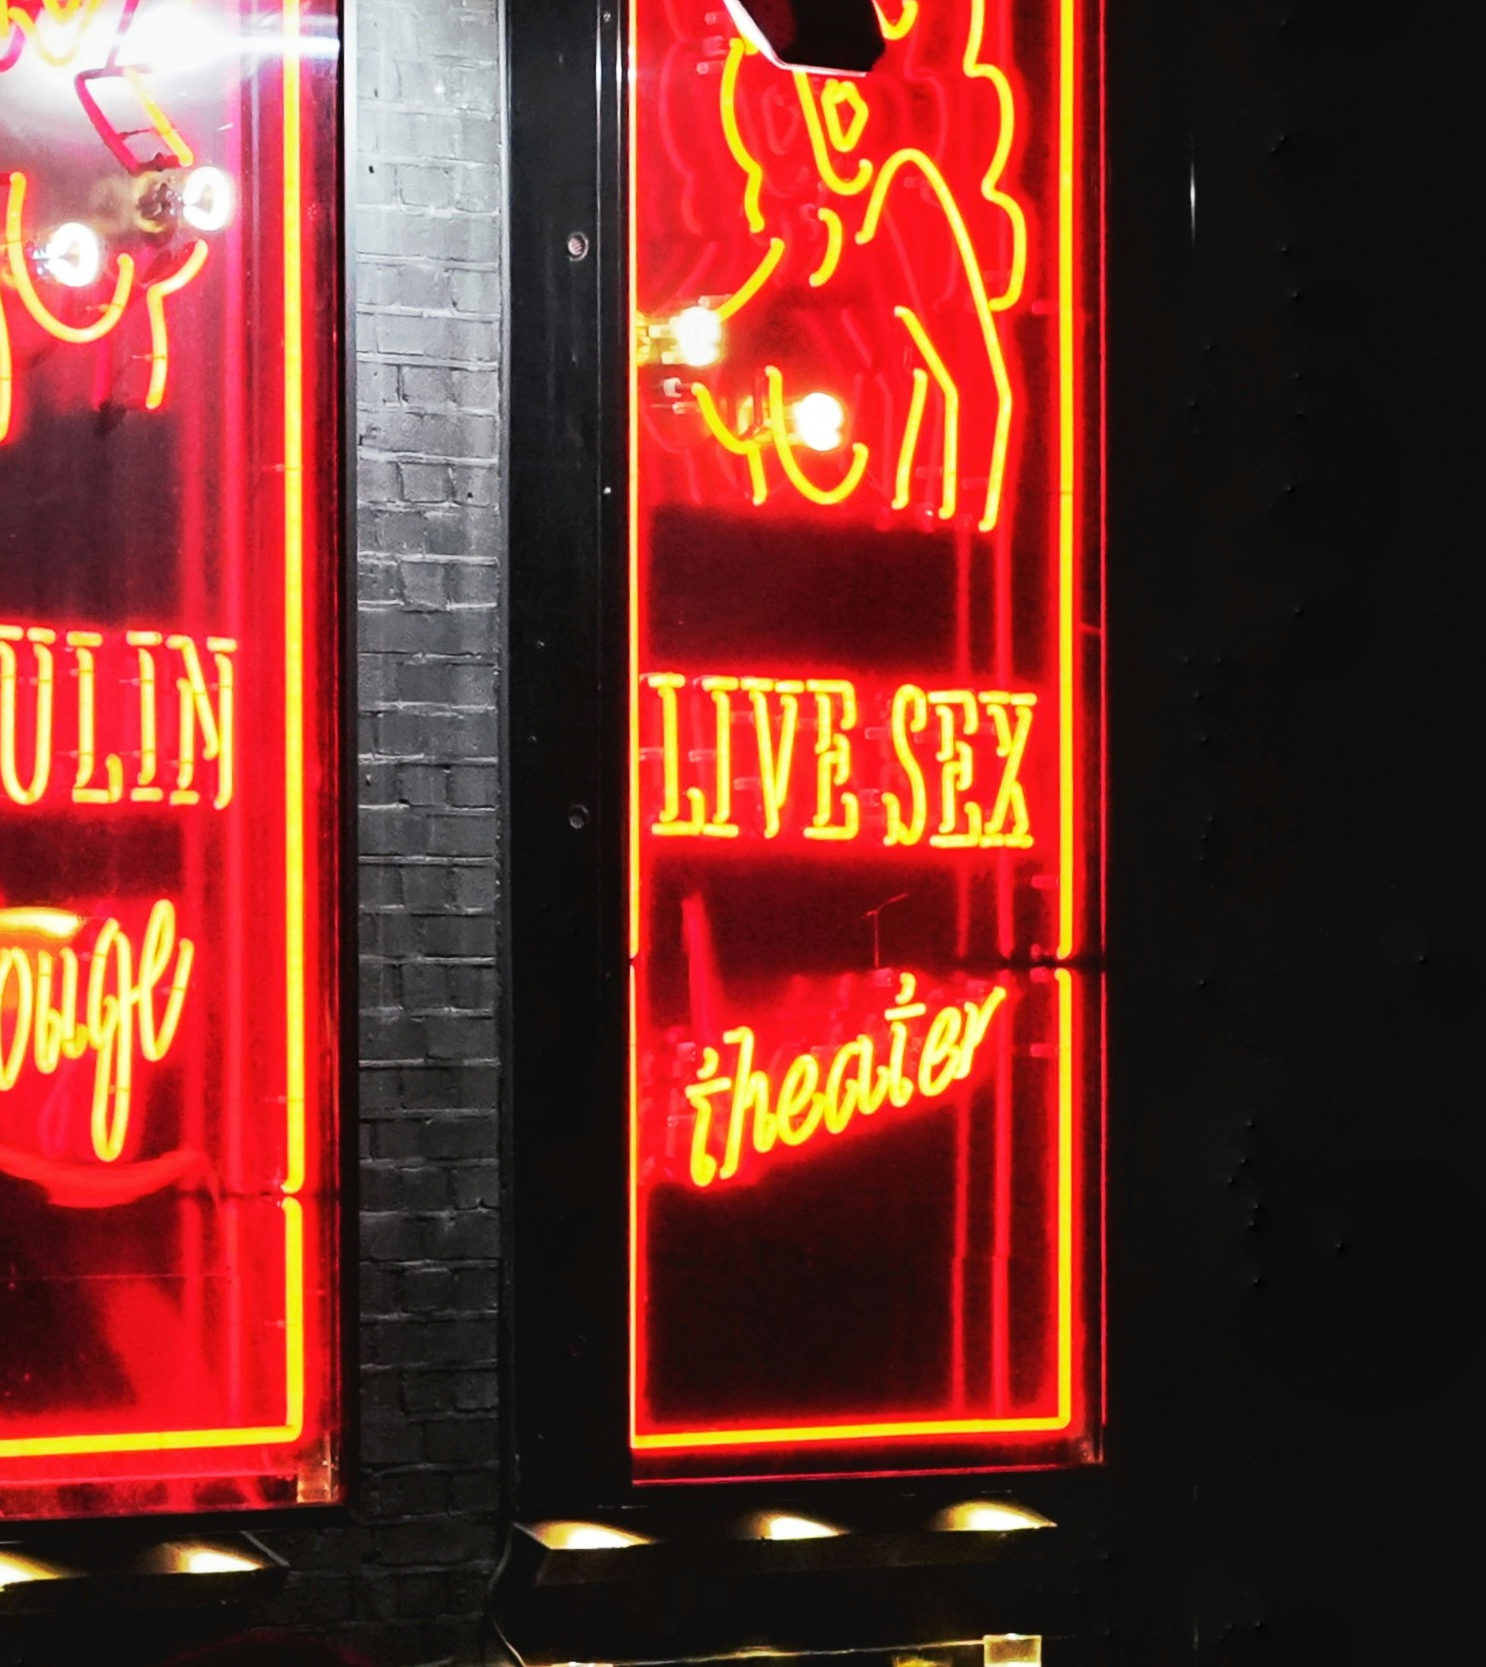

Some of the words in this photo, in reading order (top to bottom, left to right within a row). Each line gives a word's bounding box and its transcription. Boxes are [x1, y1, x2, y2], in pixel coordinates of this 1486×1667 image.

[647, 672, 859, 840] LIVE
[881, 684, 1038, 849] SEX
[685, 972, 1006, 1187] theater
